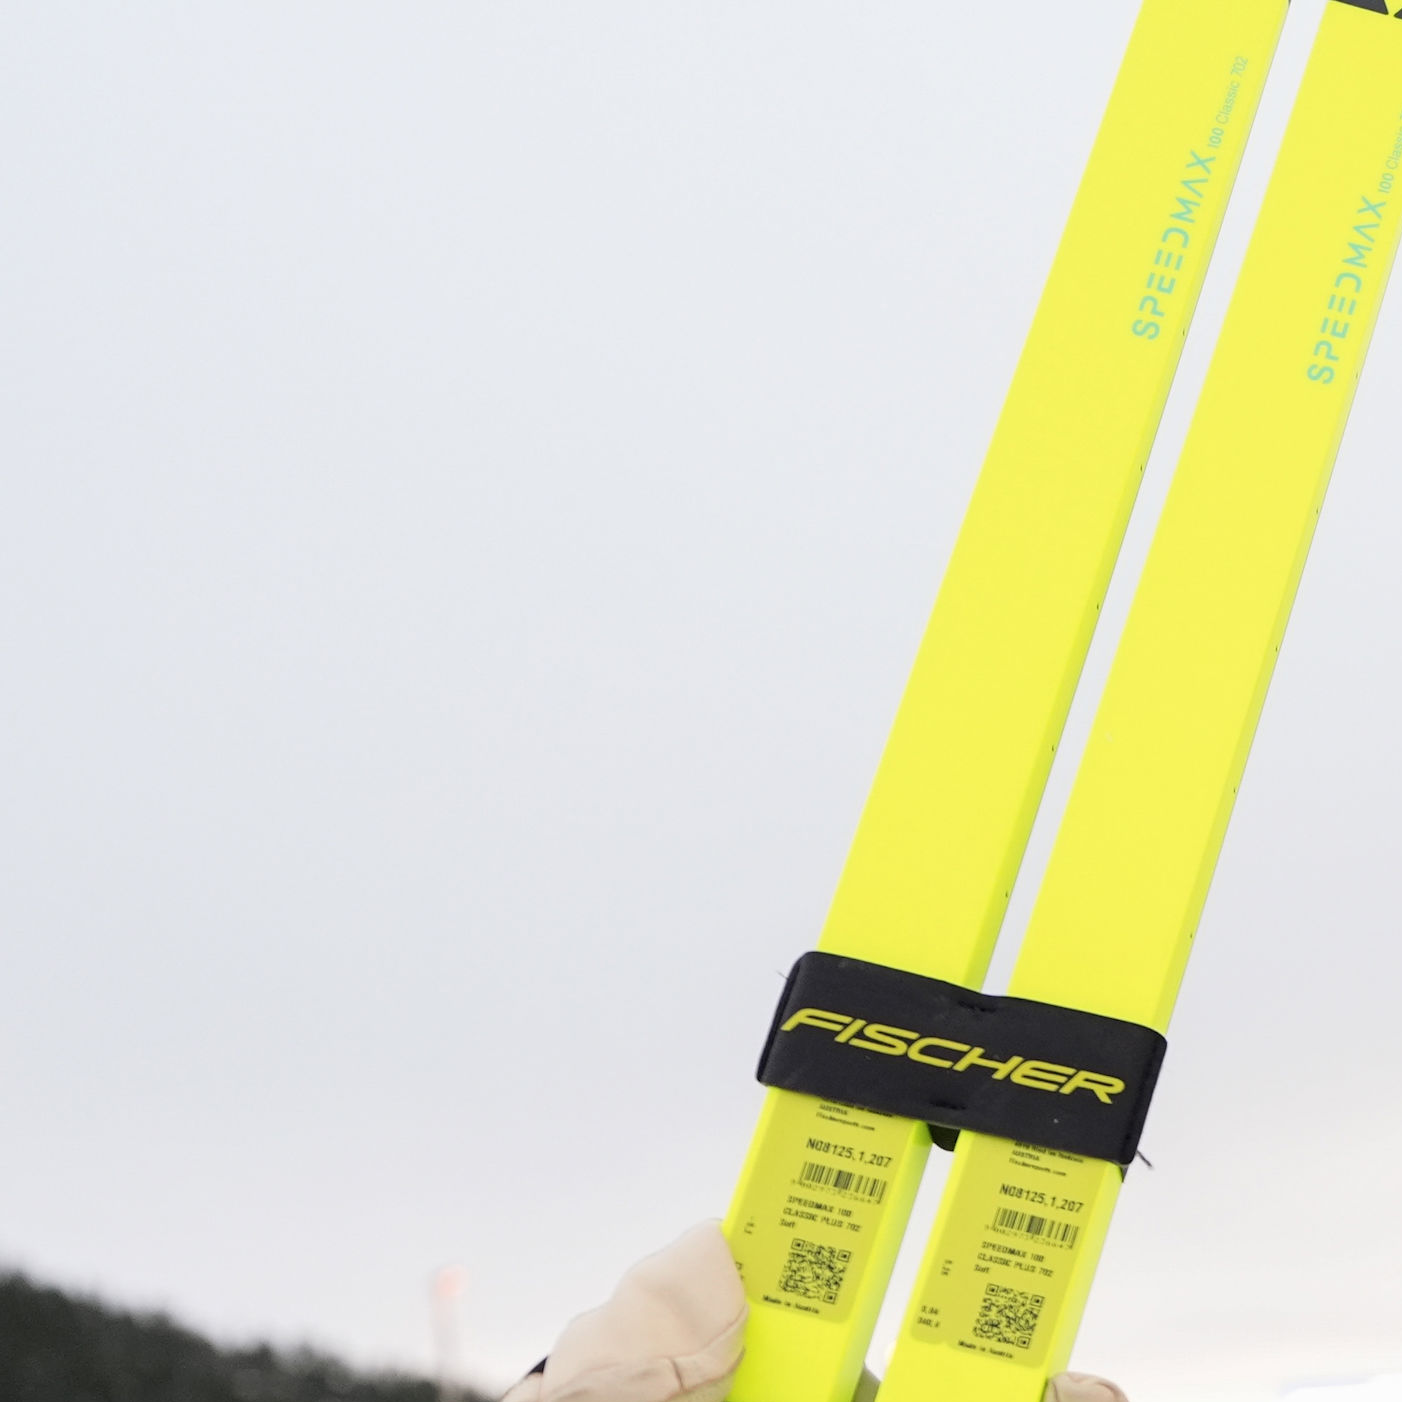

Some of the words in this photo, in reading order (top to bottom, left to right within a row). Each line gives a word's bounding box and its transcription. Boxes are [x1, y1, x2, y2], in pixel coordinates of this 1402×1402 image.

[1132, 150, 1216, 340] SPEEDMAX
[1207, 127, 1224, 149] 100
[1216, 80, 1240, 125] Classic
[1230, 56, 1248, 77] 702
[1307, 195, 1386, 384] SPEEDMAX
[1378, 173, 1395, 194] 100
[781, 1007, 1126, 1104] FISCHER
